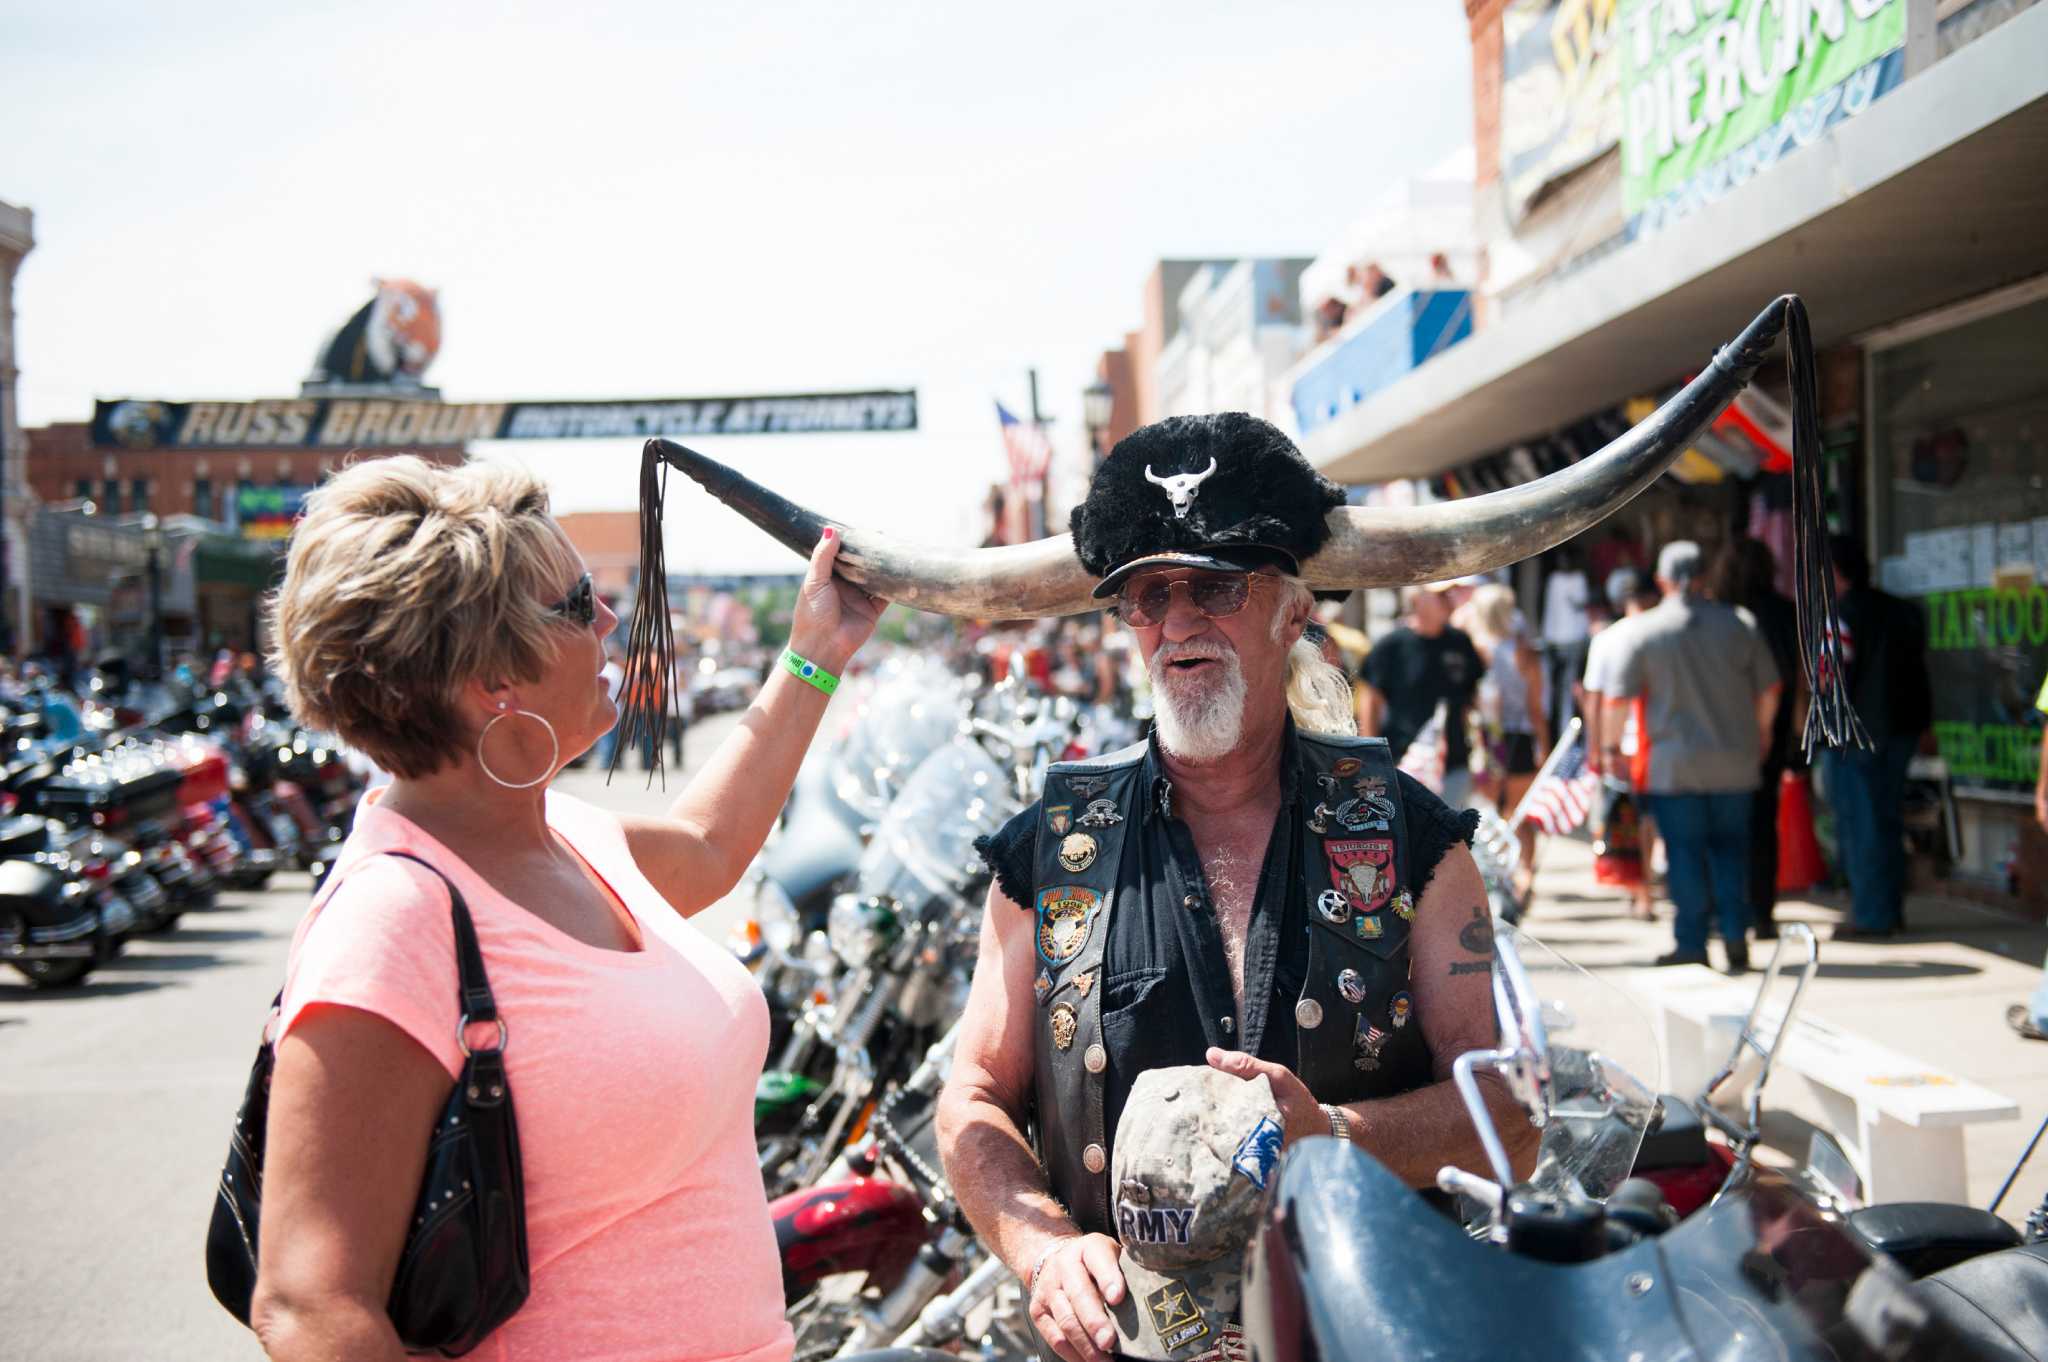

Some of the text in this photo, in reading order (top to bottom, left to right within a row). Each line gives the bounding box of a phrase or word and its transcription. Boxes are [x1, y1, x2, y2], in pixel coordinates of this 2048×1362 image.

[1628, 0, 1898, 177] PIERCIN
[178, 401, 504, 445] RUSS BROWN
[1119, 1203, 1195, 1245] RMY
